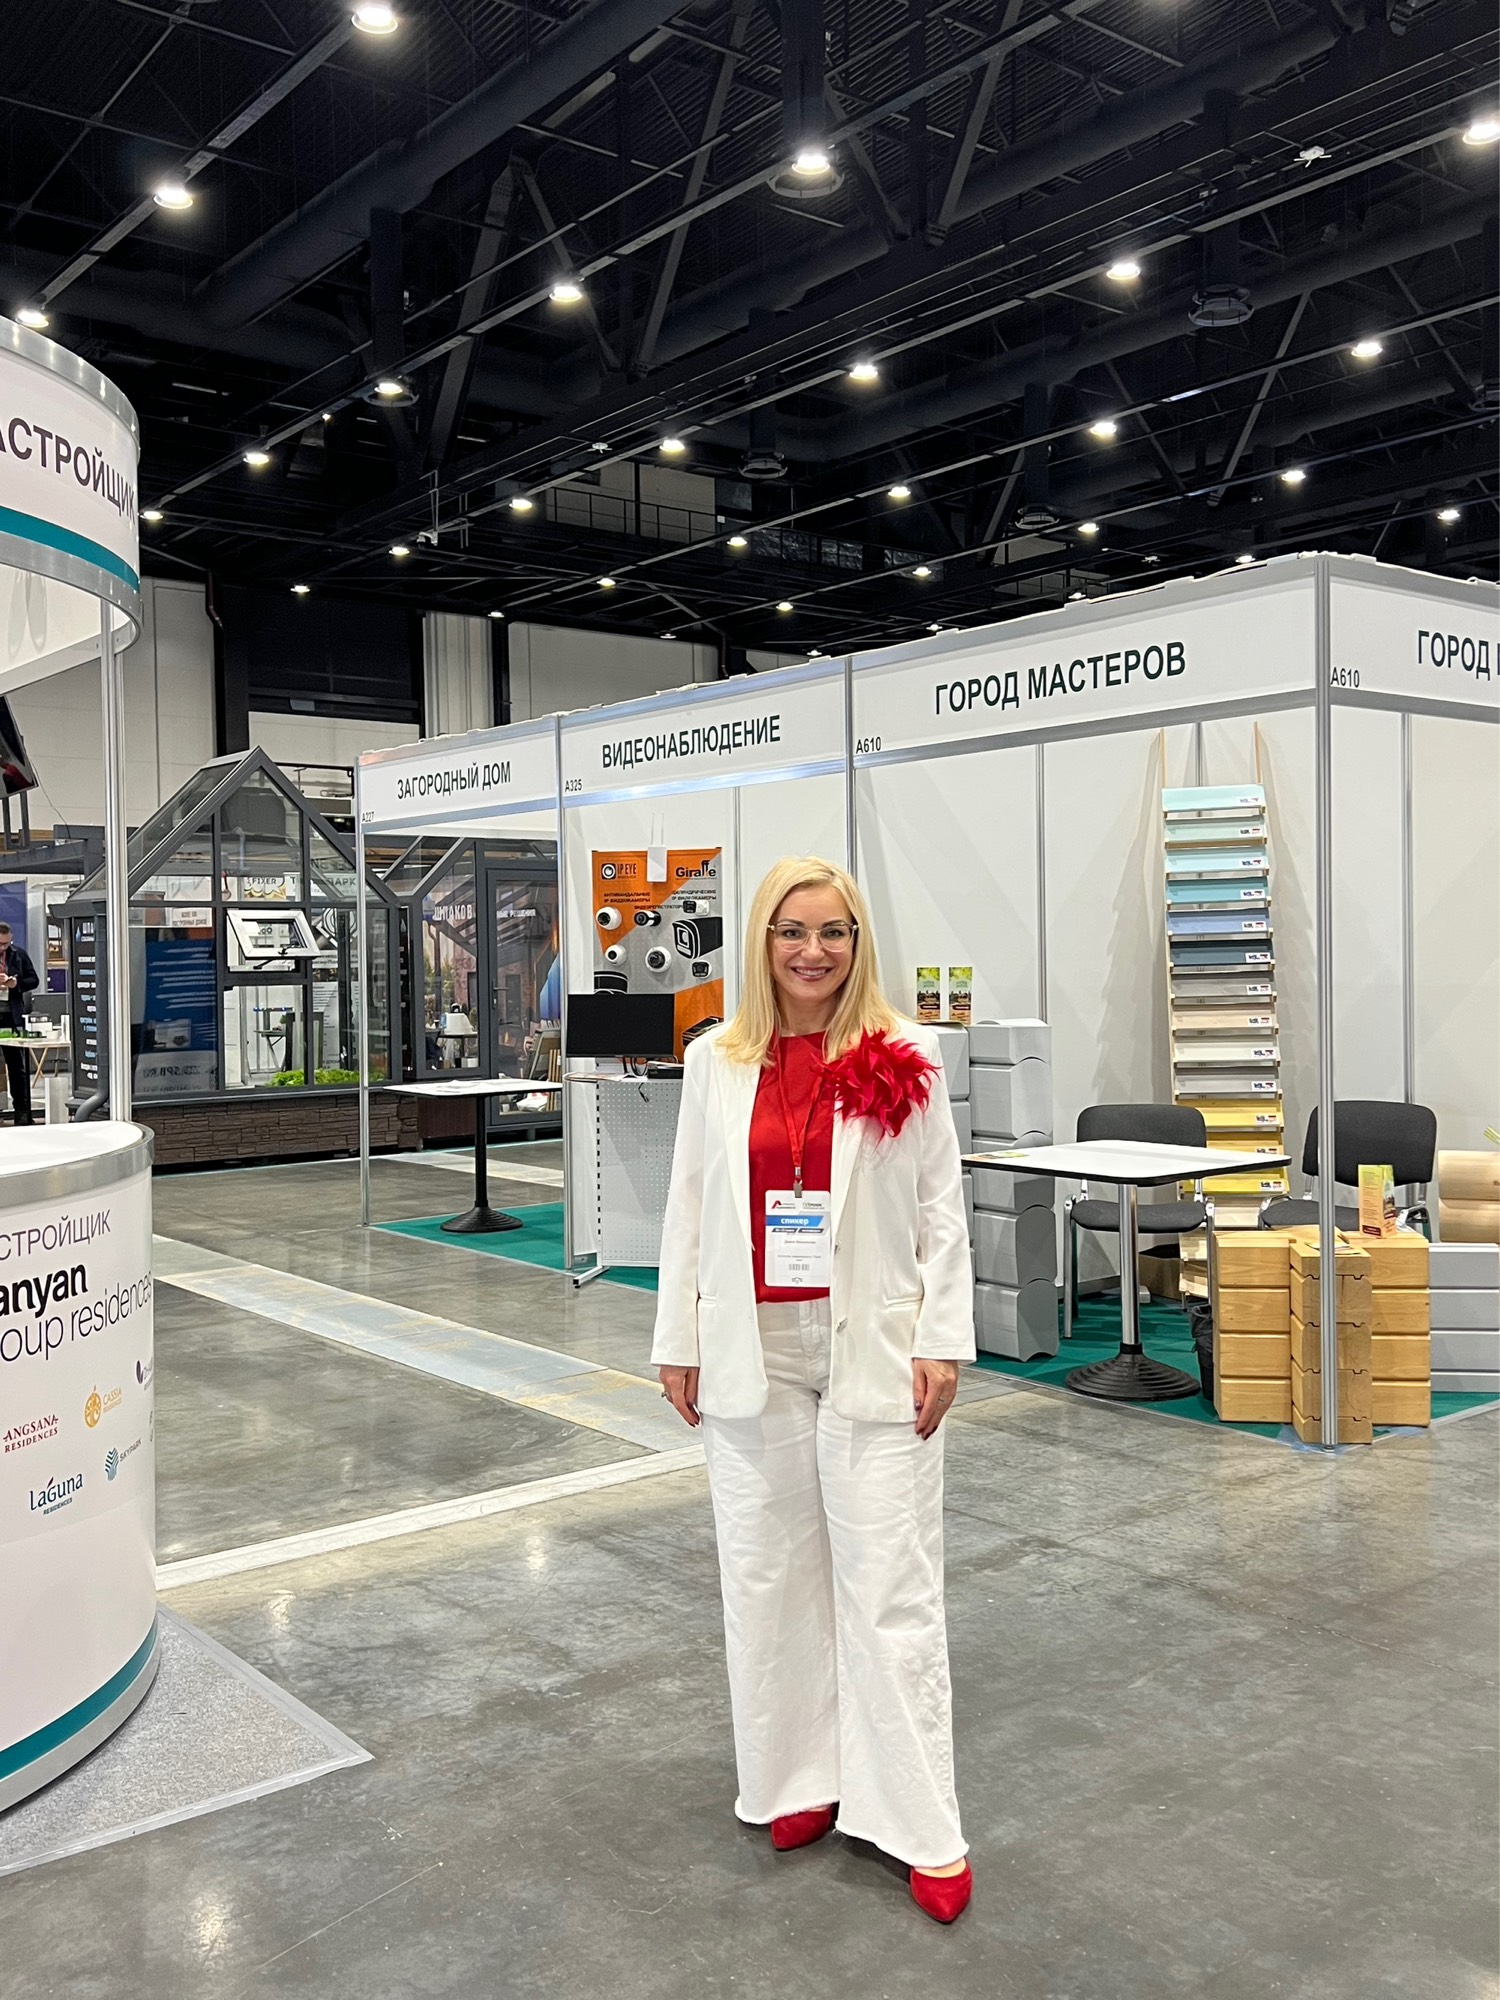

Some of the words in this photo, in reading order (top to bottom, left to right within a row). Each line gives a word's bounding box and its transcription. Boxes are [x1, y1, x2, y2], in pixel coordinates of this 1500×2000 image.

[0, 417, 135, 525] СТРОЙЩИК
[1417, 629, 1491, 682] ГОРОД
[935, 670, 1020, 716] ГОРОД
[1027, 641, 1186, 701] МАСТЕРОВ
[1330, 666, 1361, 690] A610
[602, 714, 781, 771] ВИДЕОНАБЛЮДЕНИЕ
[855, 736, 882, 754] A610
[397, 762, 479, 800] ЗАГОРОДНЫЙ
[482, 760, 511, 792] ДОМ
[564, 779, 583, 793] A325
[675, 860, 717, 878] Giraffe
[780, 1217, 809, 1226] спикер
[0, 1316, 64, 1361] oup
[3, 1414, 59, 1442] ANGSANA
[4, 1427, 58, 1453] RESIDENCES
